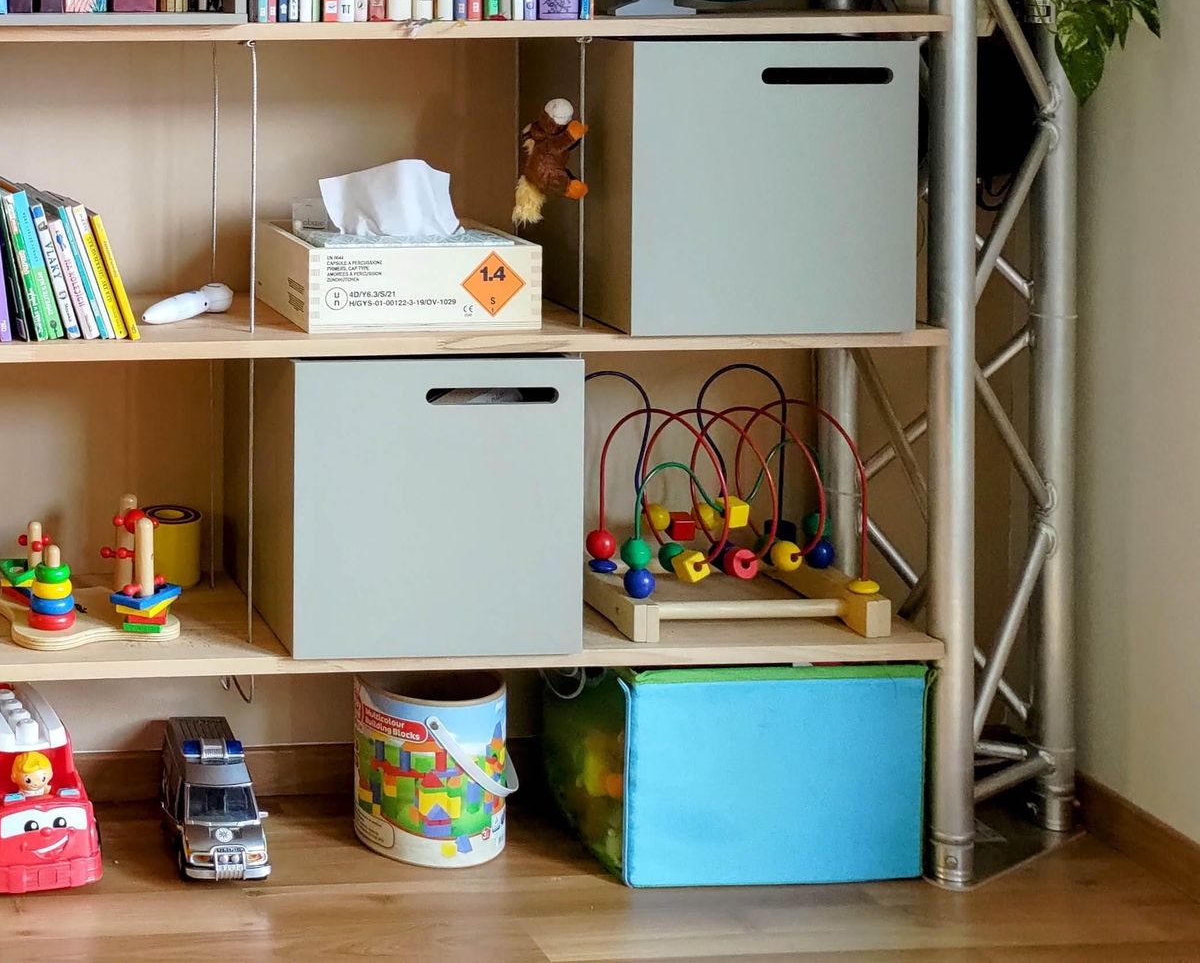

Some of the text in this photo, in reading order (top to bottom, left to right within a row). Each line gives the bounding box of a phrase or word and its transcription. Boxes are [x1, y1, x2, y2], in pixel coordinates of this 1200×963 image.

[44, 240, 62, 280] VLAKY
[480, 266, 506, 281] 1.4
[365, 708, 405, 729] Multicolour
[392, 727, 420, 741] Blocks
